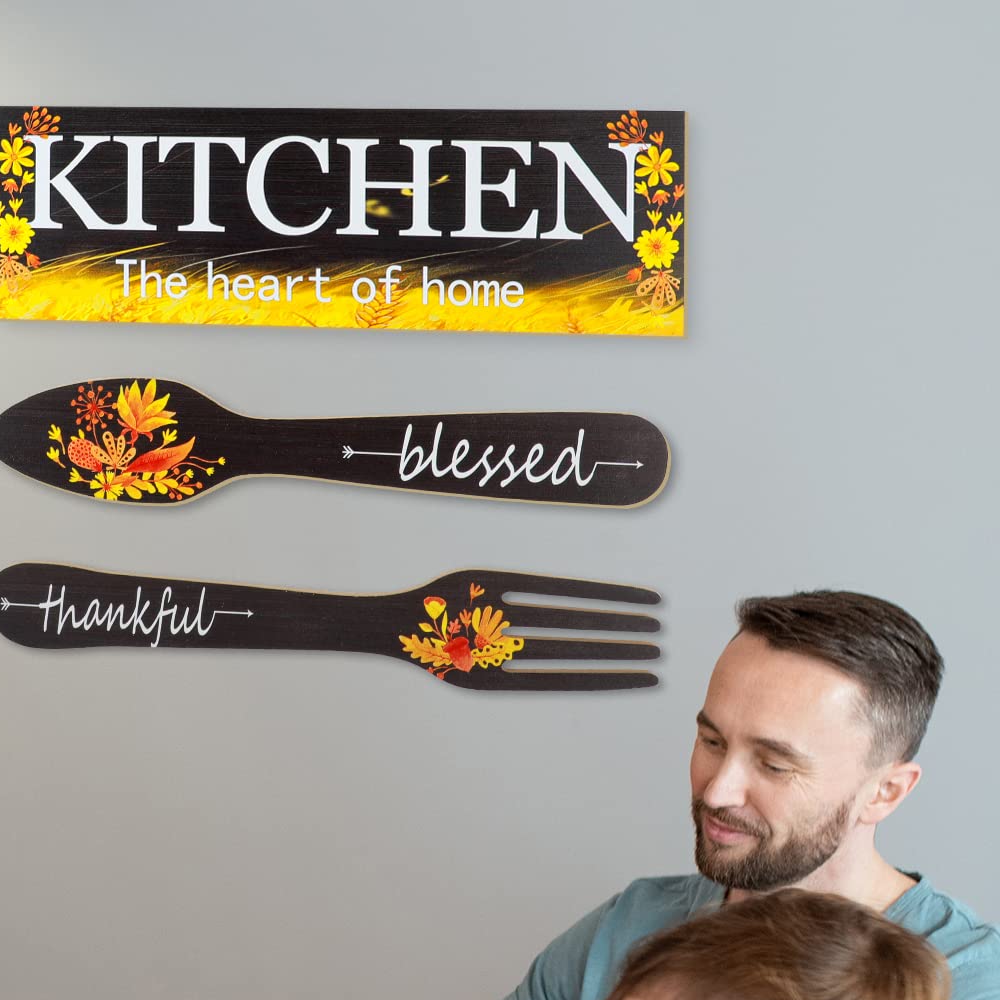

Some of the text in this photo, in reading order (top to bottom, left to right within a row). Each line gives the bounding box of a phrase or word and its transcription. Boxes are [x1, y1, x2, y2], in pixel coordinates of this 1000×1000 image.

[24, 135, 651, 243] KITCHEN
[115, 259, 524, 308] The heart of home
[399, 421, 597, 488] blessed
[38, 583, 216, 648] thankful
